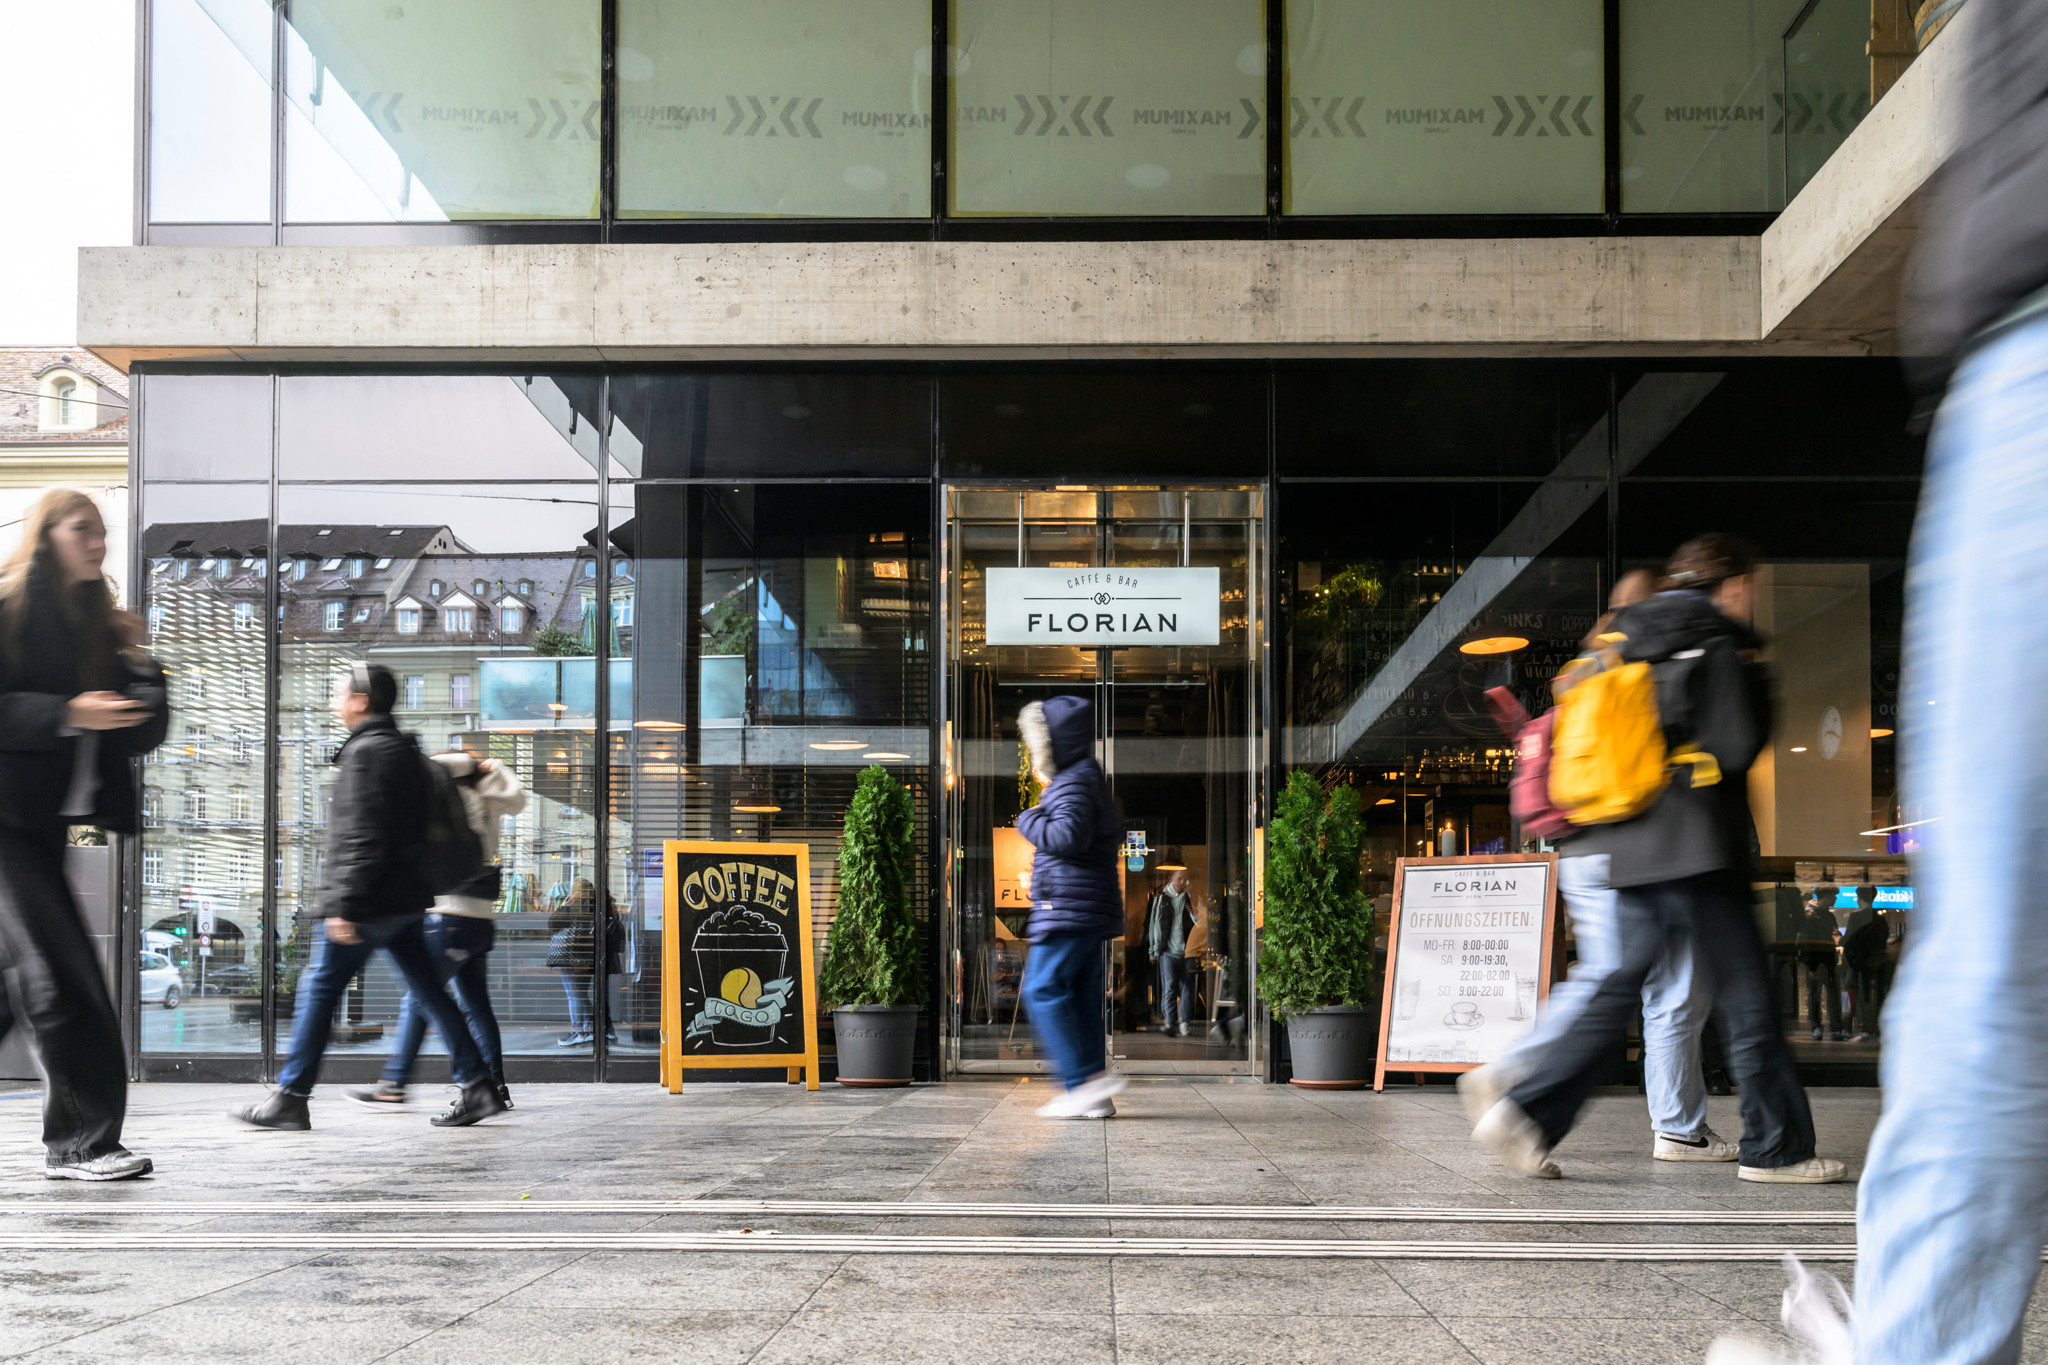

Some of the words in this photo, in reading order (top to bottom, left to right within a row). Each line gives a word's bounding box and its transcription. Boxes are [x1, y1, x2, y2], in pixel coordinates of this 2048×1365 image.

[1106, 573, 1112, 584] &
[1118, 575, 1138, 588] BAR
[1028, 612, 1177, 633] FLORIAN
[1531, 653, 1574, 665] LATT
[682, 861, 796, 917] COFFEE
[1433, 880, 1517, 893] FLORIAN
[1409, 911, 1535, 928] ÖFFNUNGSZEITEN:
[1462, 939, 1509, 951] 8:00-00:00
[1461, 954, 1508, 967] 9:00-19:30,
[1460, 970, 1510, 981] 22:00-02:00
[1458, 985, 1504, 997] 9:00-22:00
